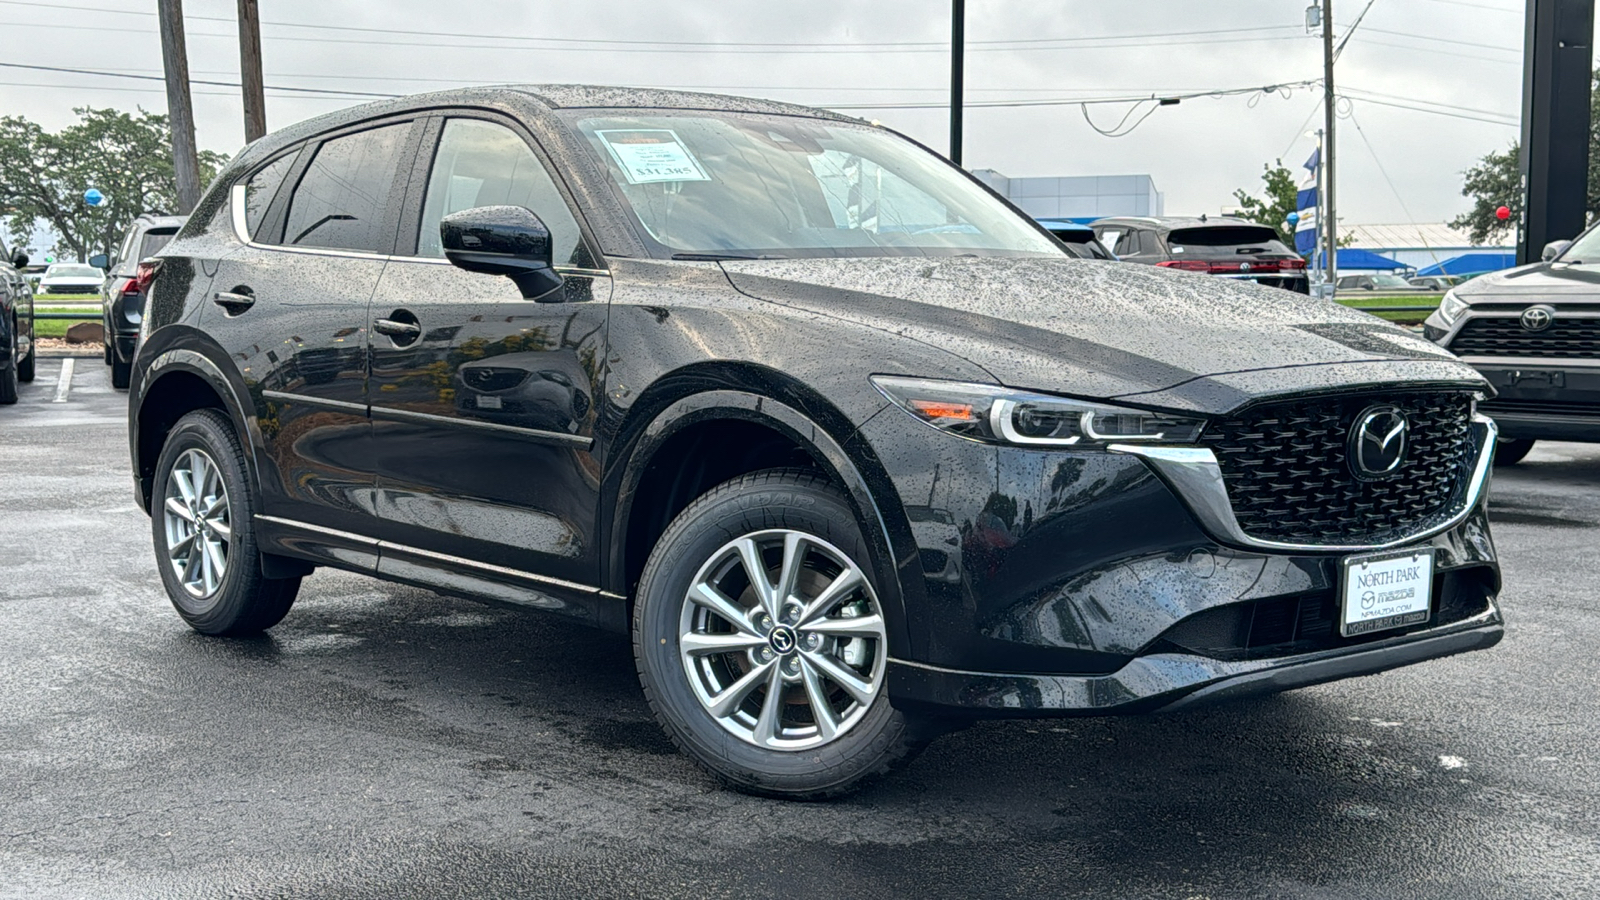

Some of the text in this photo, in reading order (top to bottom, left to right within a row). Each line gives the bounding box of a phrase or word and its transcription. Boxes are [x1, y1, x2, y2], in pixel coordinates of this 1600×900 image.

[1357, 566, 1420, 589] NORTH PARK
[1361, 604, 1412, 619] NPMAZDA.COM
[1348, 619, 1374, 635] NORTH
[1374, 617, 1394, 630] PARK
